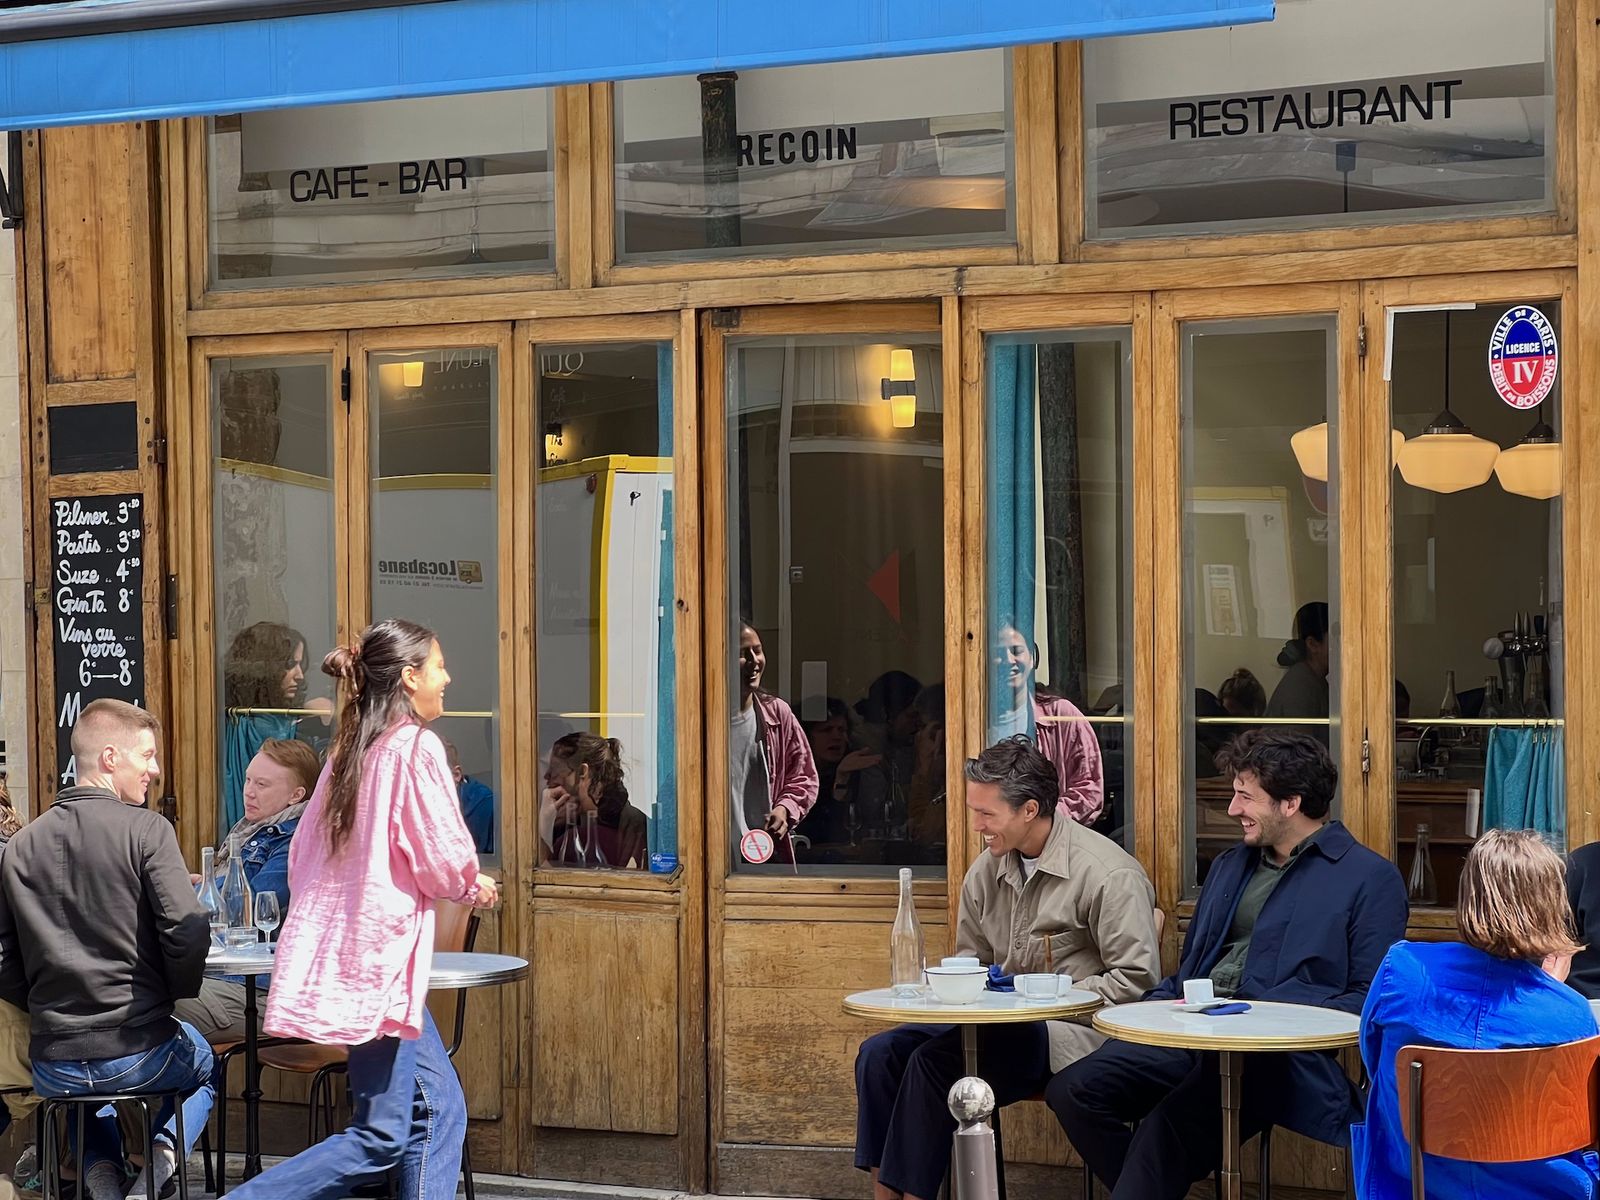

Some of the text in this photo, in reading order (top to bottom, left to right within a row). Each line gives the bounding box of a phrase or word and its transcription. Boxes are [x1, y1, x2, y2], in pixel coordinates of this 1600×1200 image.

[1170, 80, 1462, 140] RESTAURANT
[737, 127, 856, 167] RECOIN
[290, 165, 369, 203] CAFE
[399, 158, 467, 194] BAR
[1492, 309, 1554, 351] VILLE DE PARIS
[1505, 342, 1541, 355] LICENCE
[1492, 362, 1511, 394] DEBIT
[1516, 358, 1555, 407] BOISSONS
[1512, 360, 1539, 384] IV
[55, 500, 110, 527] Pilsner
[57, 529, 101, 555] Pastis
[57, 559, 100, 585] Suze
[59, 617, 116, 643] Vins au
[81, 643, 126, 658] verre
